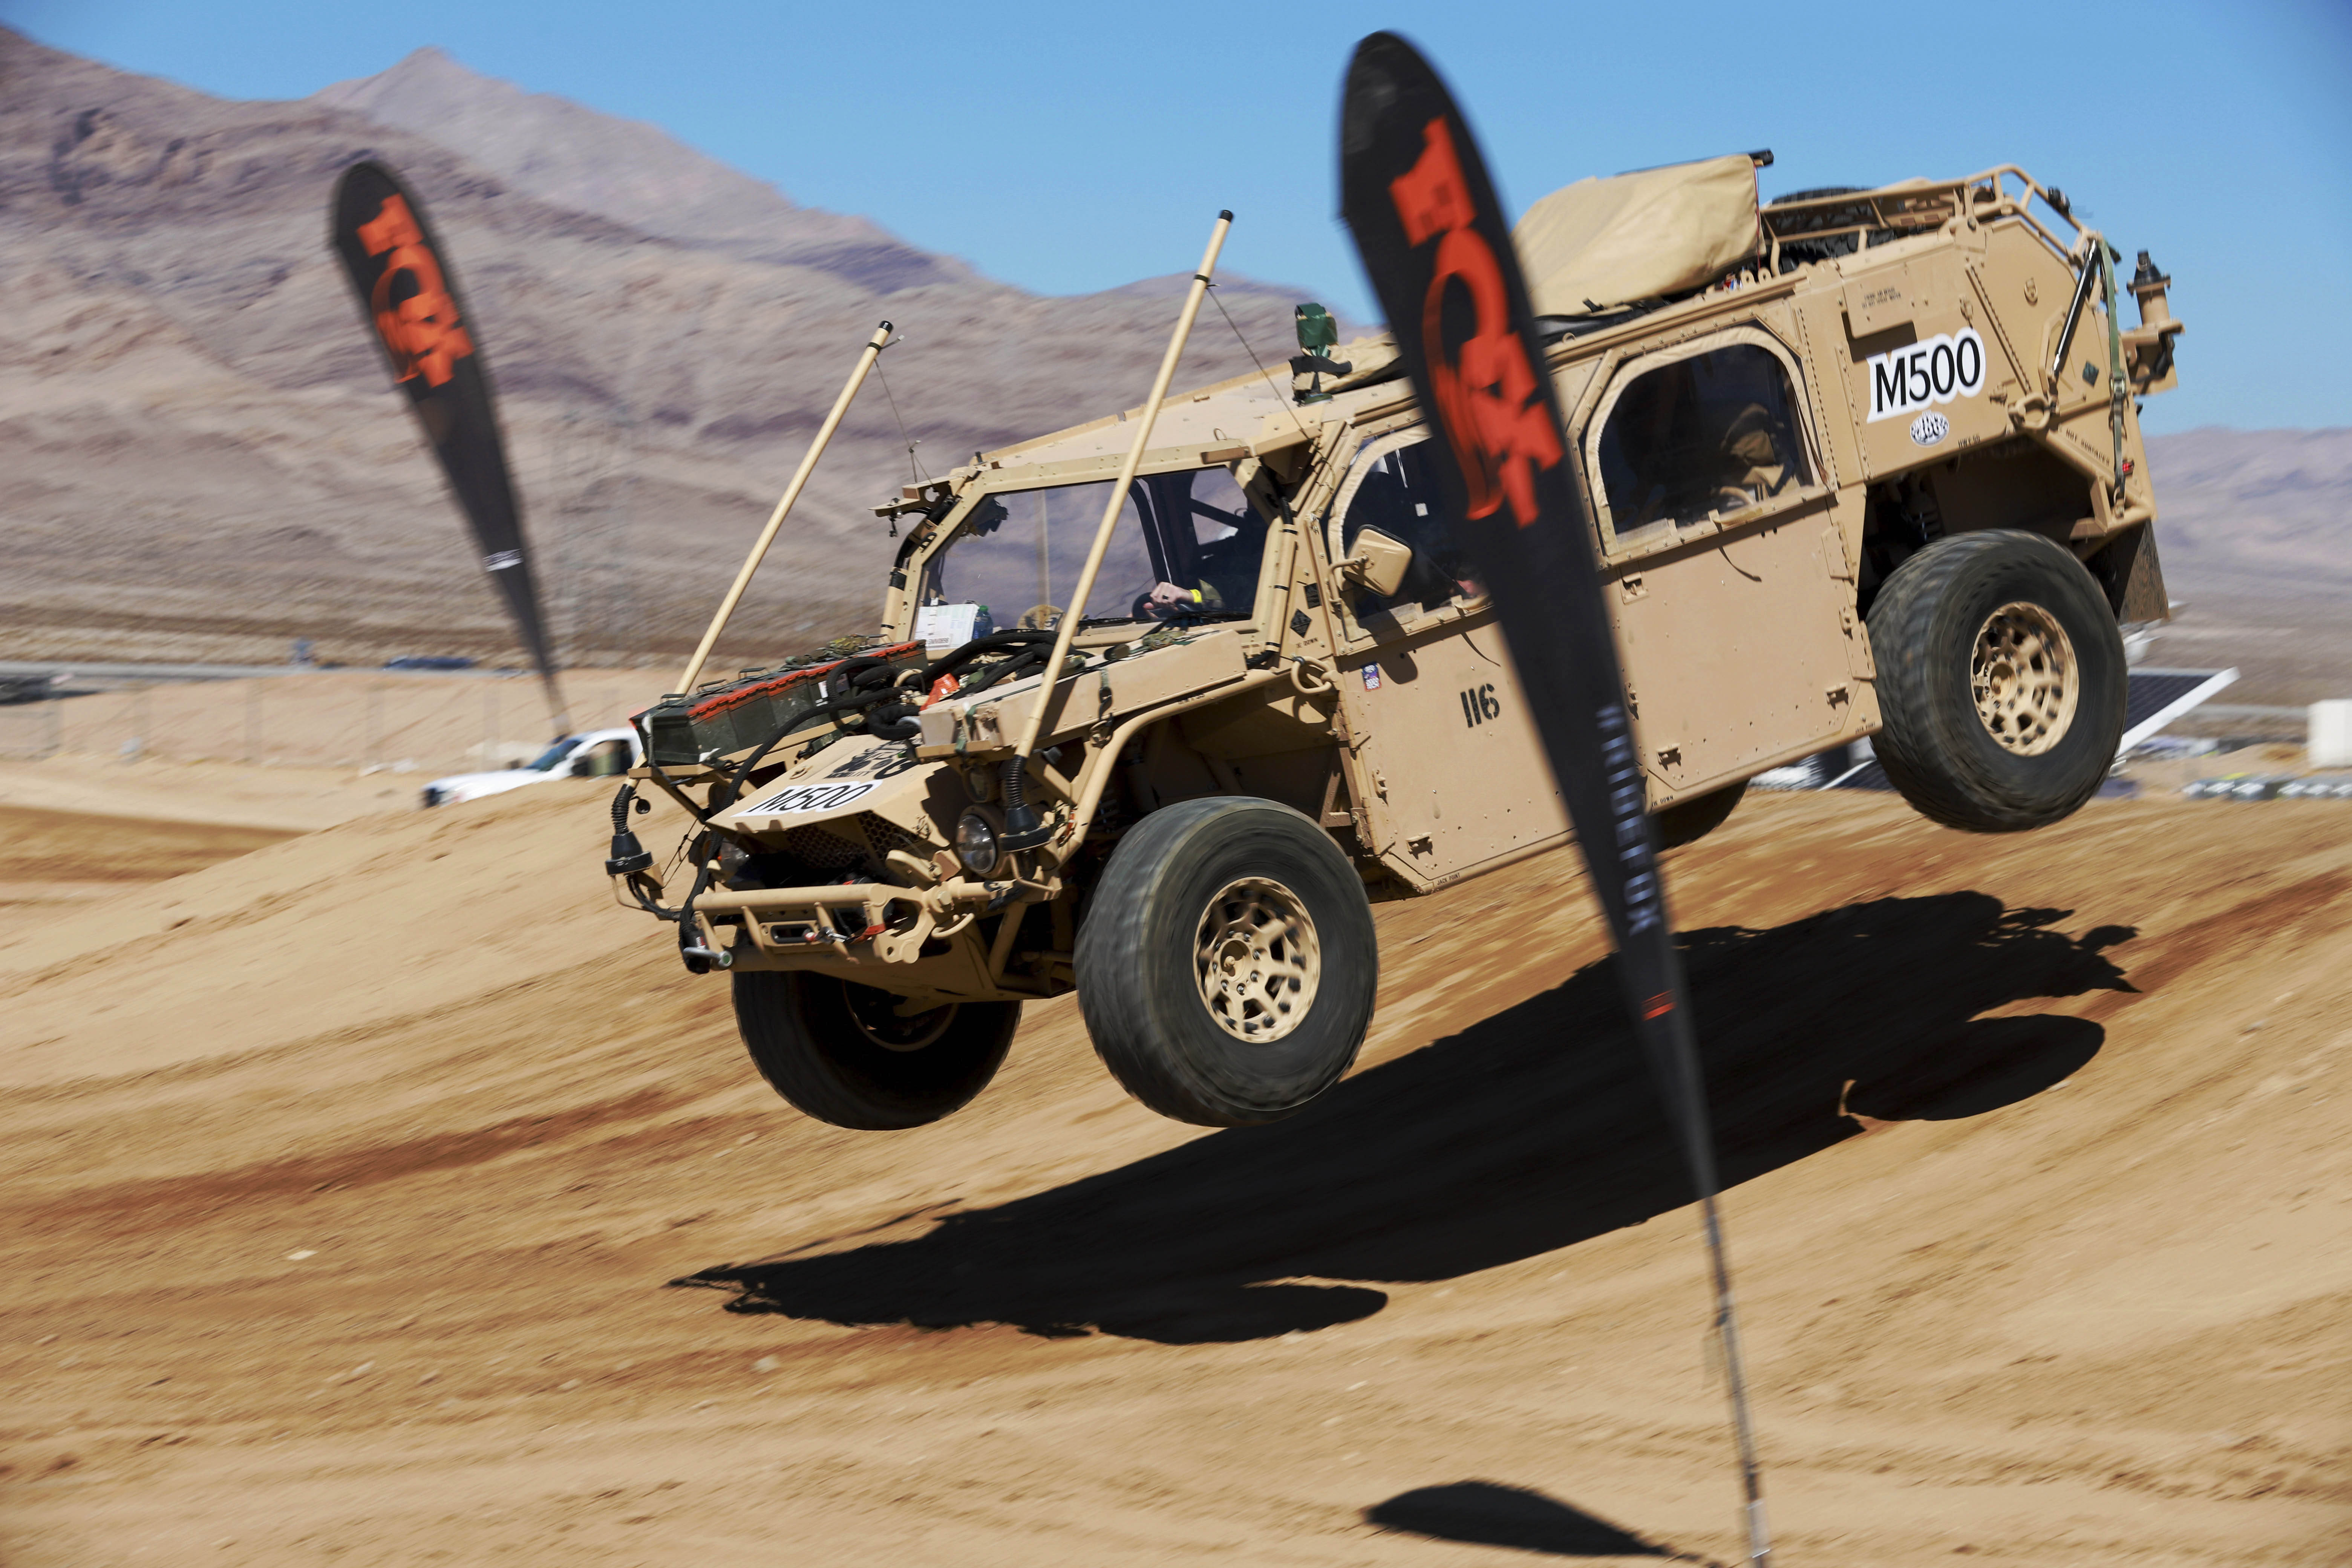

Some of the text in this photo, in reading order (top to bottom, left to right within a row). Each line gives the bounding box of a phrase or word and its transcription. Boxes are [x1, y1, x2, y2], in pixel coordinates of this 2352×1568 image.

[1389, 114, 1563, 528] FOX
[1875, 337, 1980, 413] M500
[1461, 683, 1500, 728] 116
[823, 770, 874, 779] MOBILITY
[747, 784, 873, 813] M500
